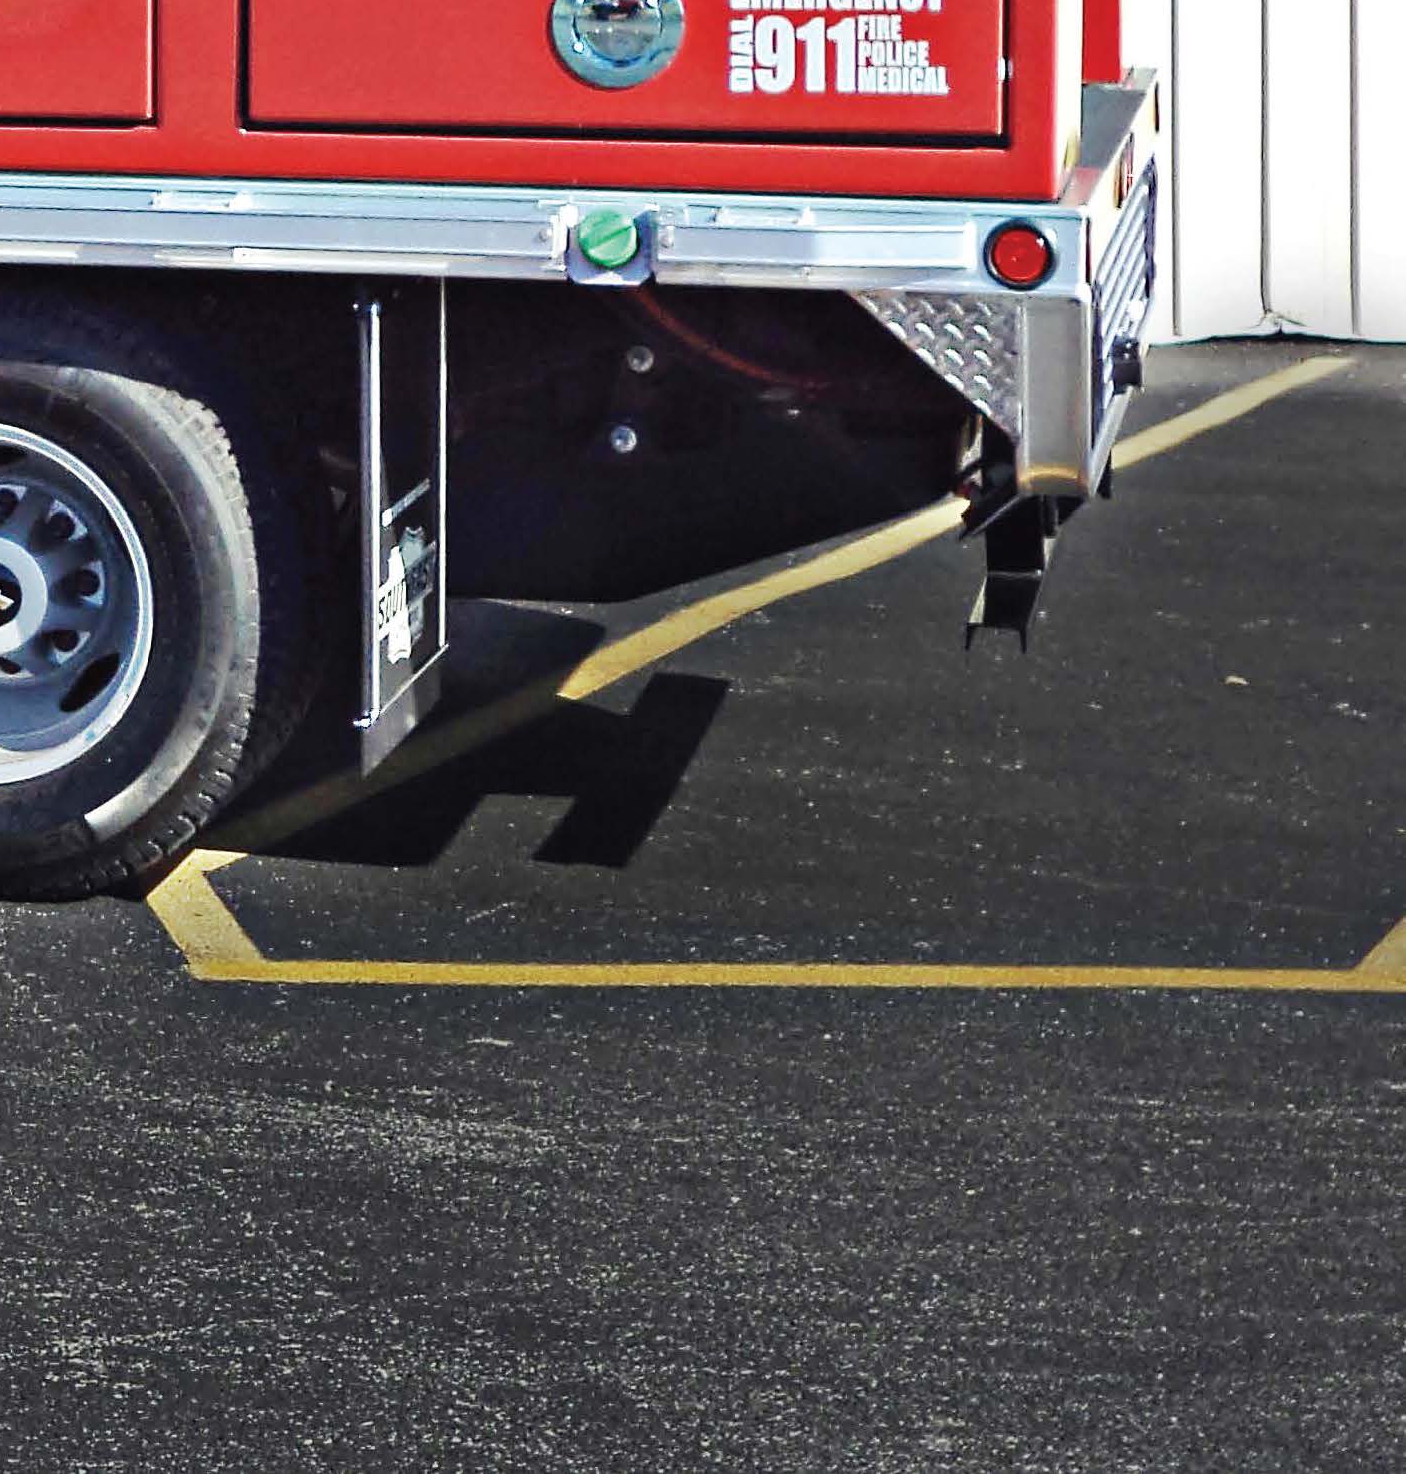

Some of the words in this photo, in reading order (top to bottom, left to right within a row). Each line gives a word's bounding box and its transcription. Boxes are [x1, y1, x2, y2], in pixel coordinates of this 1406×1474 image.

[857, 14, 902, 41] FIRE
[728, 14, 755, 93] DIAL
[754, 14, 857, 93] 911
[857, 40, 930, 67] POLICE
[857, 66, 950, 95] MEDICAL
